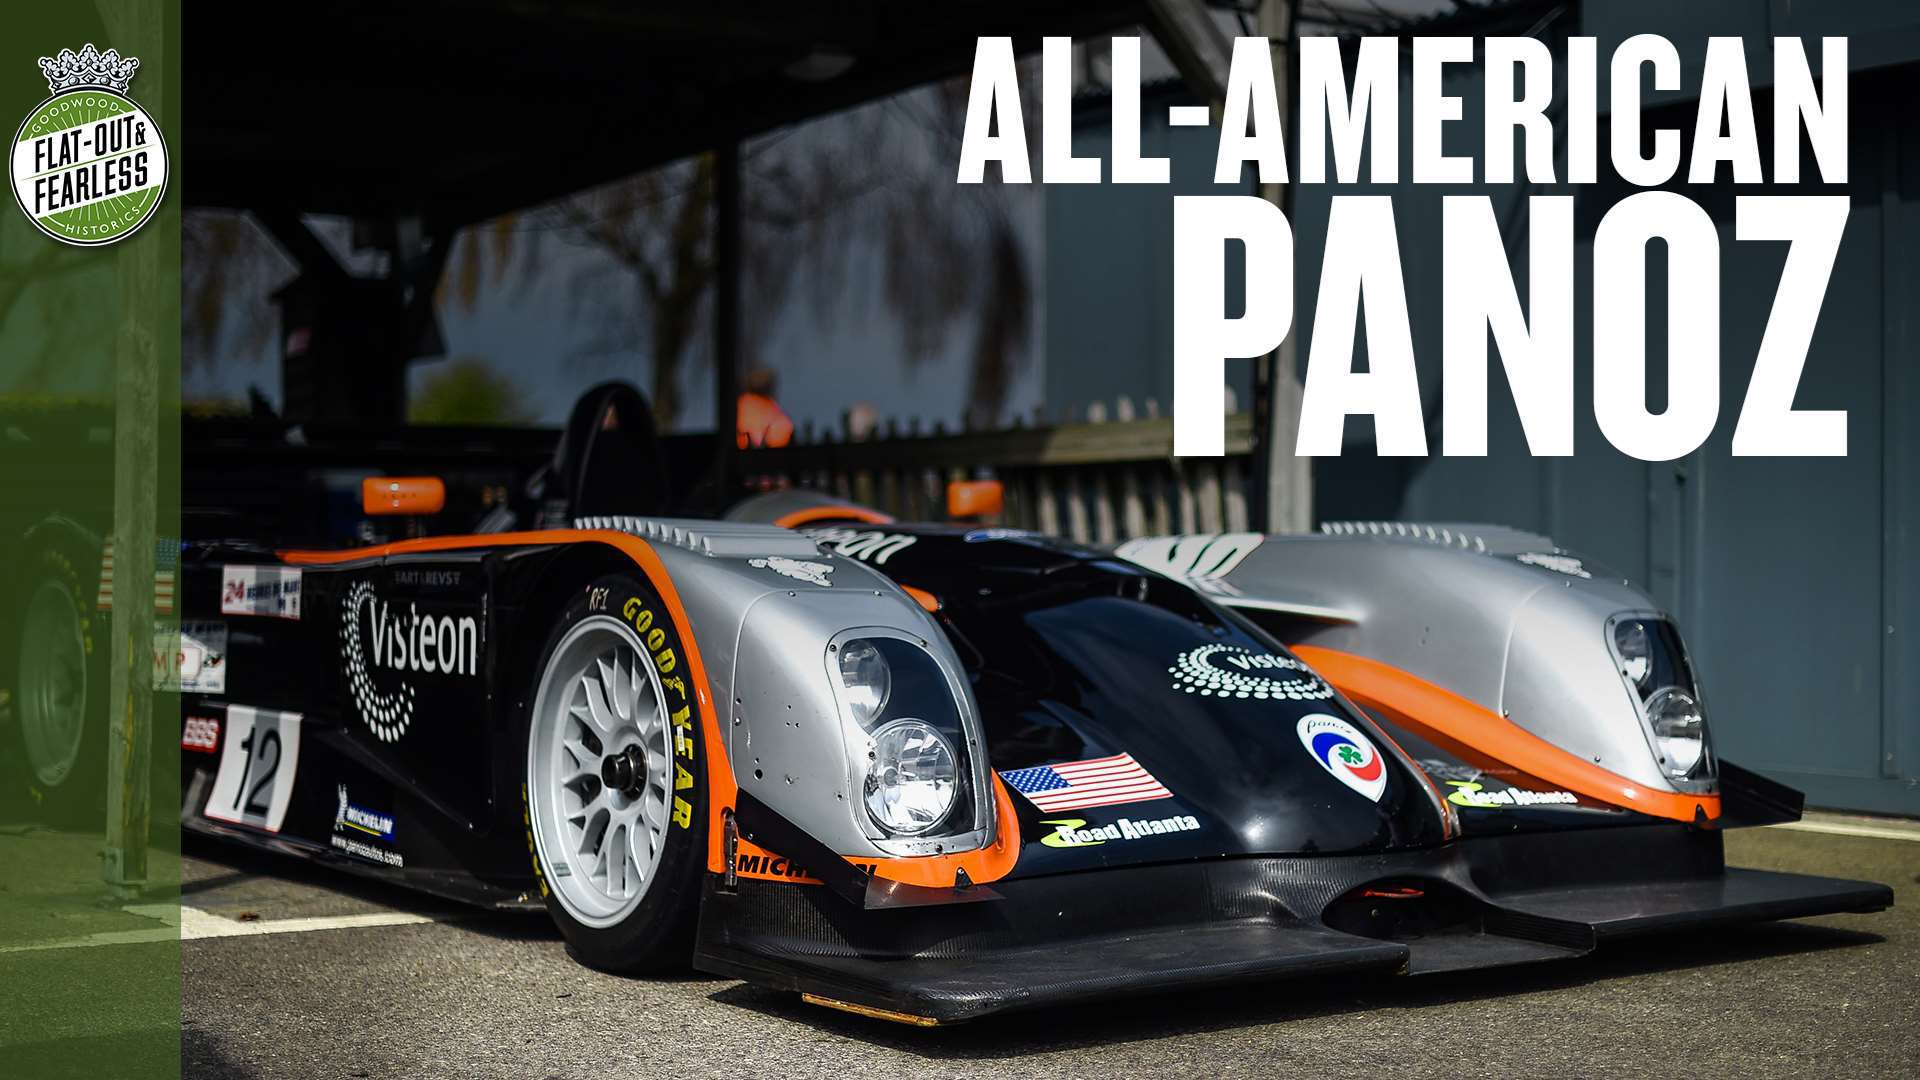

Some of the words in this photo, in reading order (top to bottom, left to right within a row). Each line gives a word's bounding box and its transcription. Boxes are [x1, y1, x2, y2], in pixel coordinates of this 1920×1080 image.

[370, 600, 476, 676] Visteon
[623, 596, 694, 830] GOODYEAR
[233, 727, 282, 817] 12
[346, 806, 393, 834] MICHELIN
[1055, 823, 1122, 846] Road
[1117, 815, 1200, 840] Atlanta
